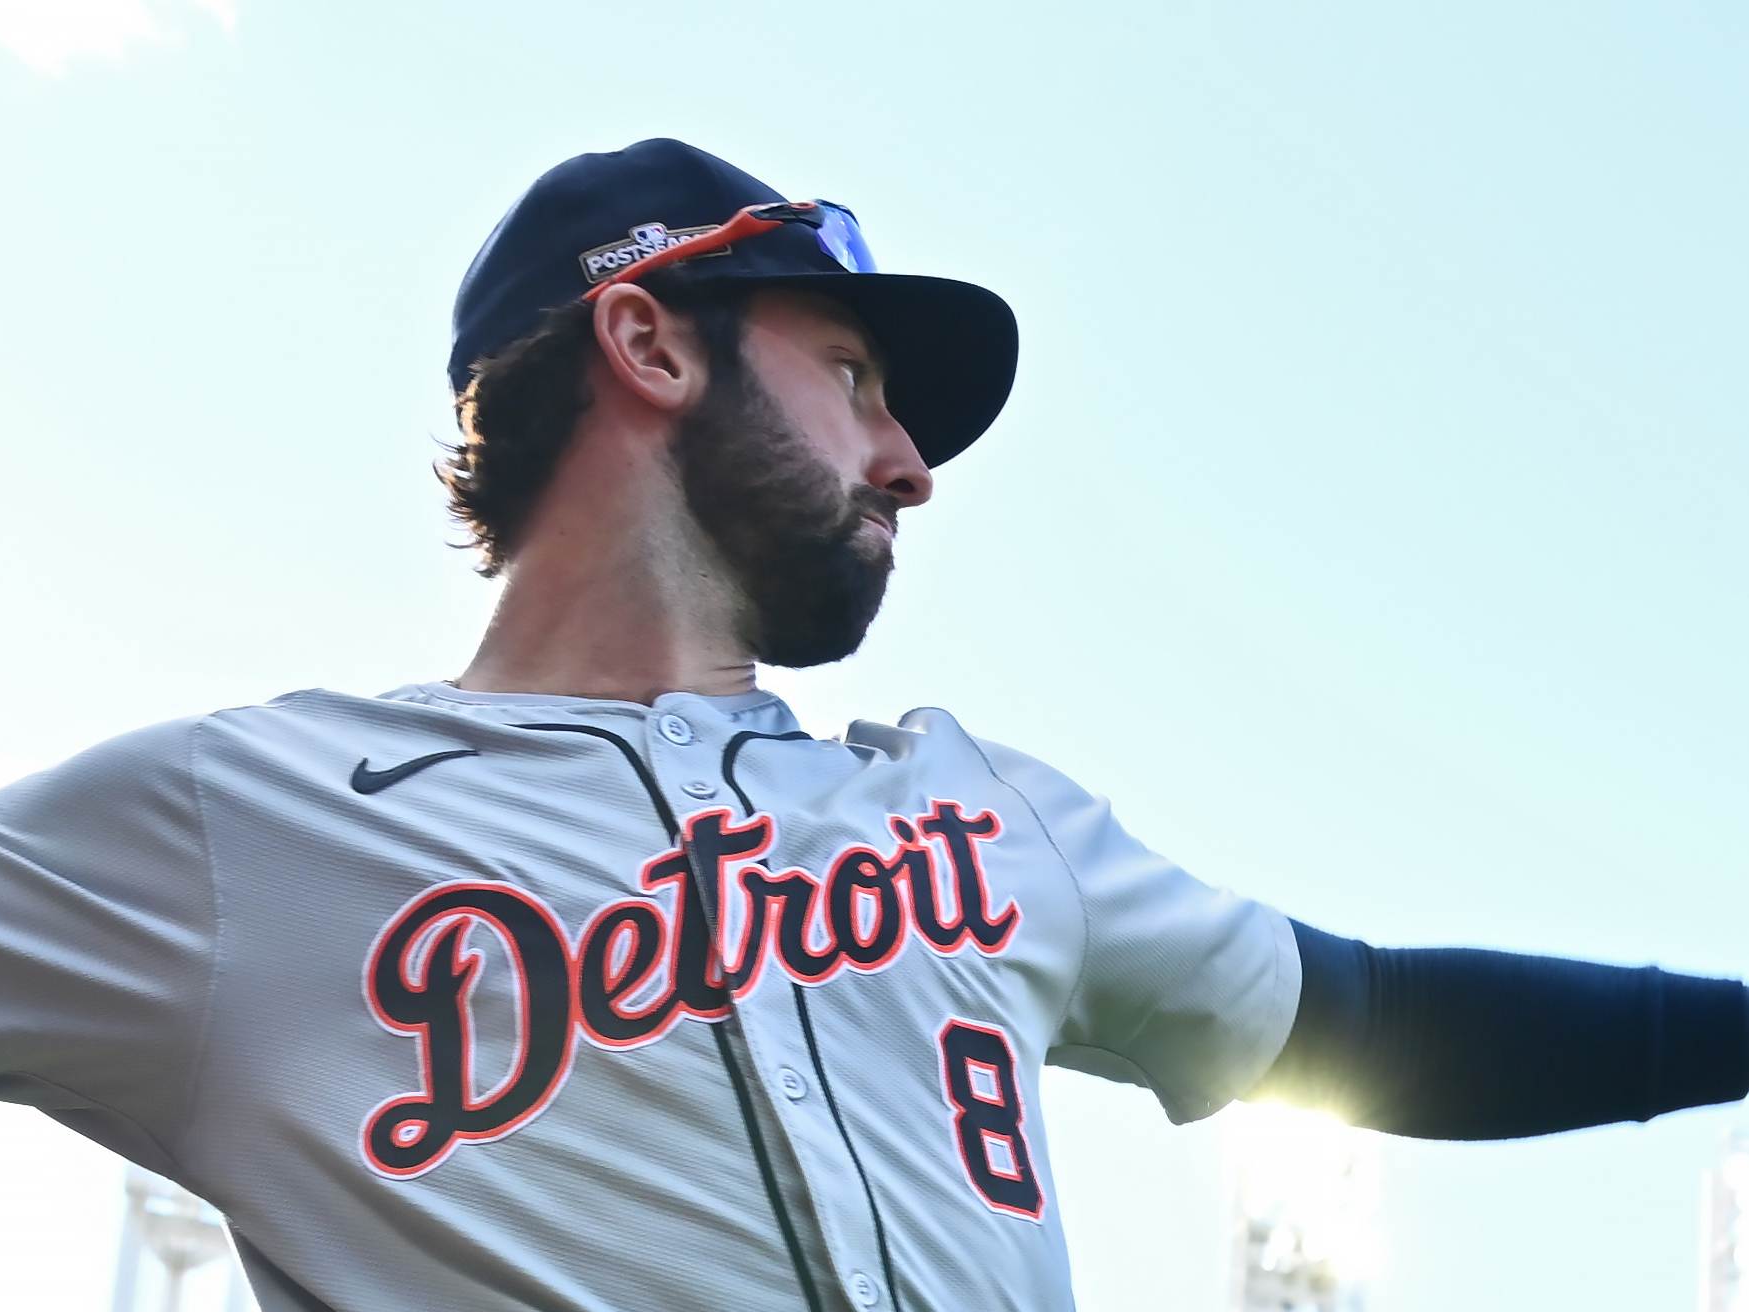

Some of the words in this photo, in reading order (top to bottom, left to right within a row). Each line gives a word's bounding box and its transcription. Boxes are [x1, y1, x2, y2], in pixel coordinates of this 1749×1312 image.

[586, 234, 700, 275] POSTSEA
[362, 799, 1023, 1180] Detroit
[934, 1016, 1048, 1225] 8
